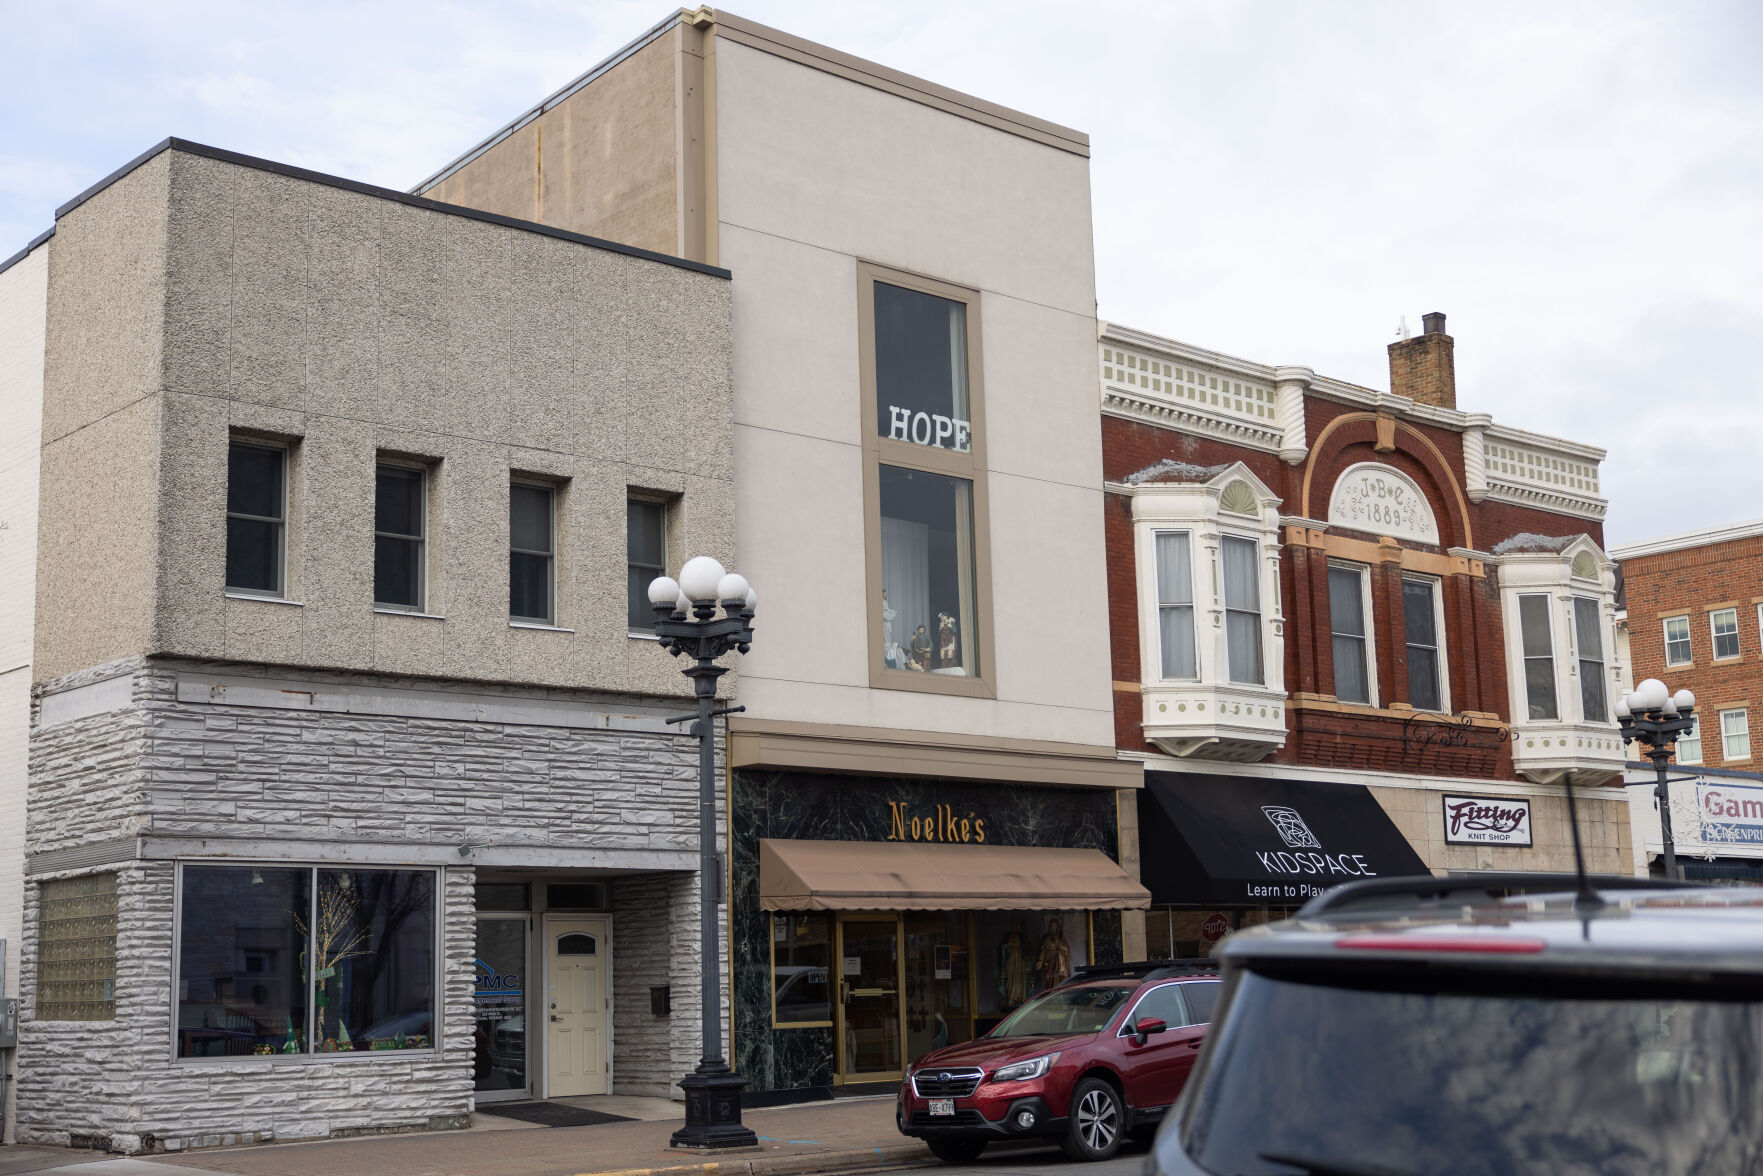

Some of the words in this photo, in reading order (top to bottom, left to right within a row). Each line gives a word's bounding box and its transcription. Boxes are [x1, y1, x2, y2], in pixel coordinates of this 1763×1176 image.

[888, 405, 970, 453] HOPE
[1366, 503, 1400, 526] 1889
[888, 801, 985, 842] Noelke's
[1448, 801, 1526, 836] Fitting
[1488, 833, 1511, 841] SHOP
[1256, 851, 1377, 876] KIDSPACE
[1247, 883, 1280, 897] Learn
[1284, 885, 1296, 897] to
